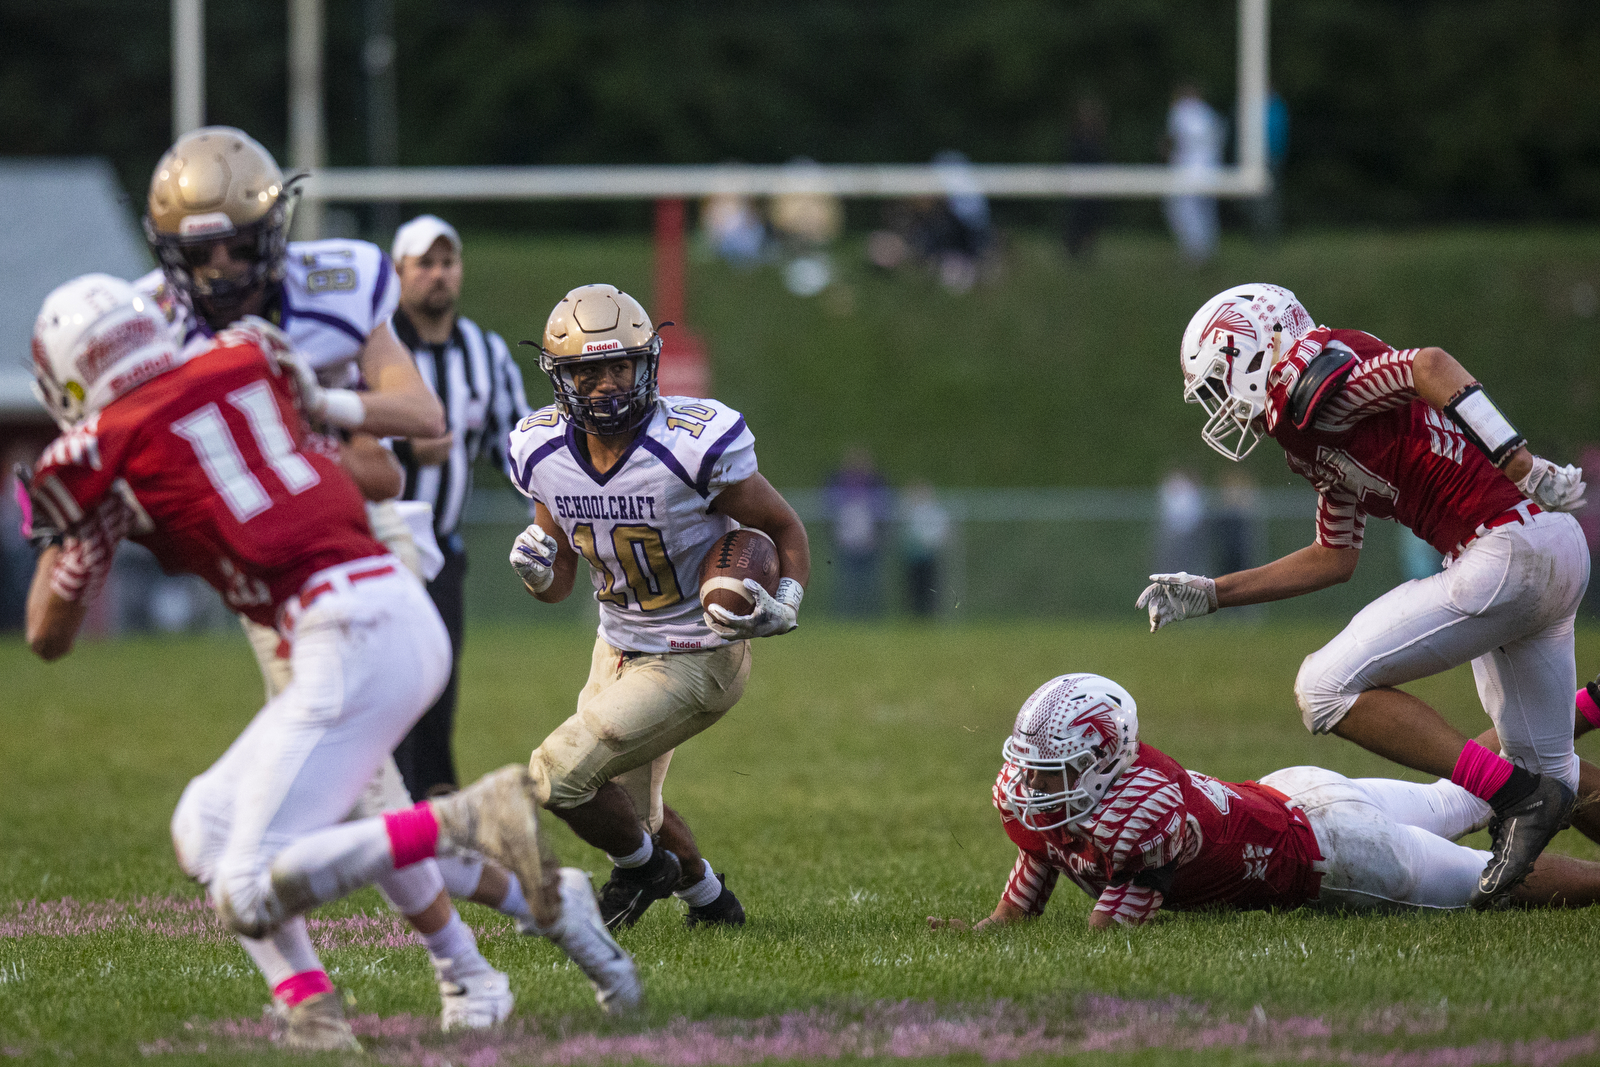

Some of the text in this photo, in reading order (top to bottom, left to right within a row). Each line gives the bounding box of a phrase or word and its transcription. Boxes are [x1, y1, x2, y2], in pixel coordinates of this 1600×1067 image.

[586, 341, 619, 353] Riddell
[666, 403, 717, 440] 10
[170, 379, 321, 524] 11
[554, 495, 656, 520] SCHOOLCRAFT
[571, 523, 685, 612] 10
[670, 640, 702, 650] Riddell
